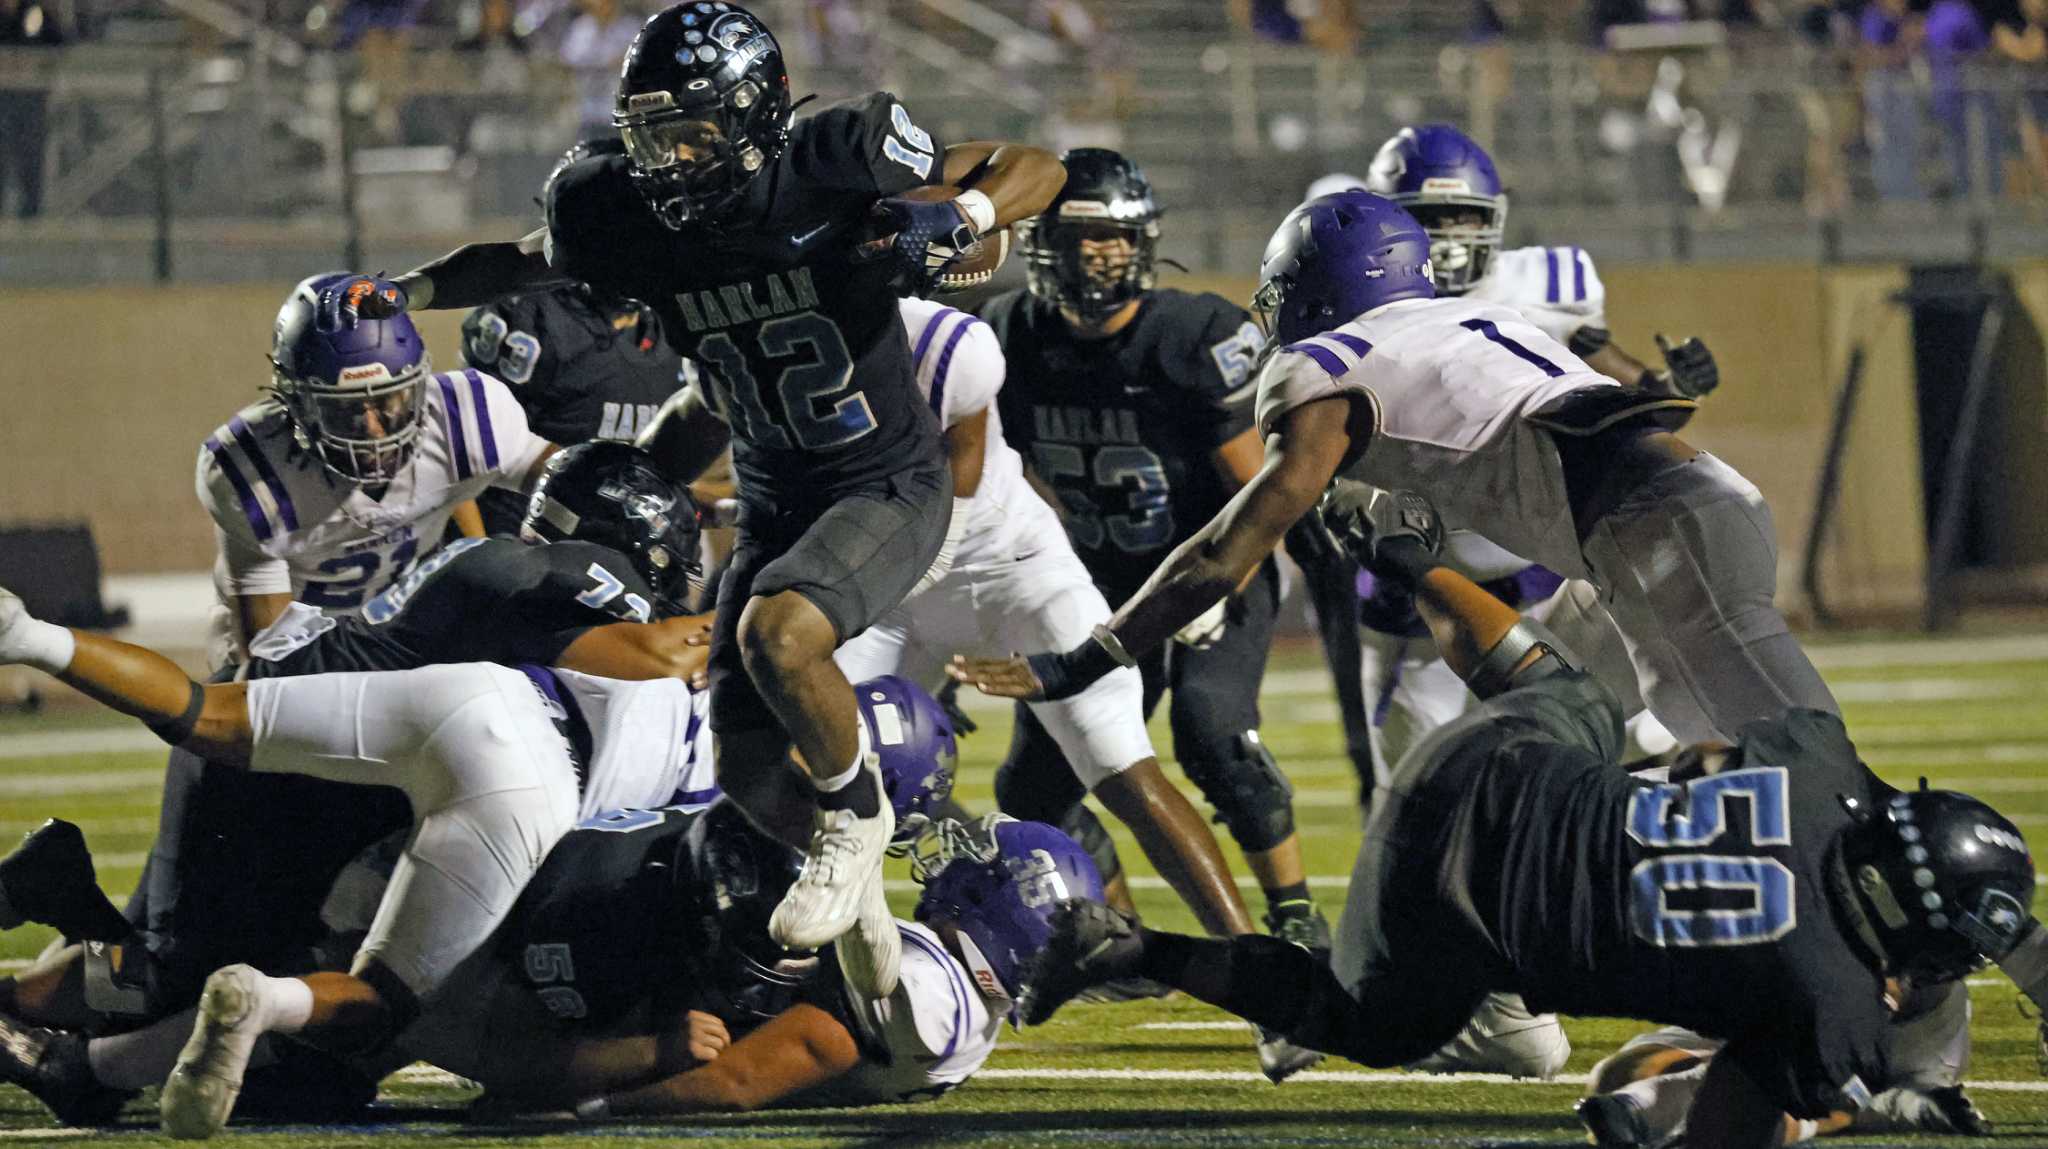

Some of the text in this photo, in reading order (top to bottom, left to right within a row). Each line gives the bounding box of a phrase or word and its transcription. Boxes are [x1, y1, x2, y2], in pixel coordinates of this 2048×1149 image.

[882, 103, 935, 181] 12
[674, 265, 820, 332] HARLAN
[469, 311, 542, 385] 33
[697, 309, 879, 450] 12
[1210, 320, 1268, 390] 53
[1459, 318, 1566, 378] 1
[1030, 440, 1177, 553] 53
[1624, 765, 1797, 948] 50
